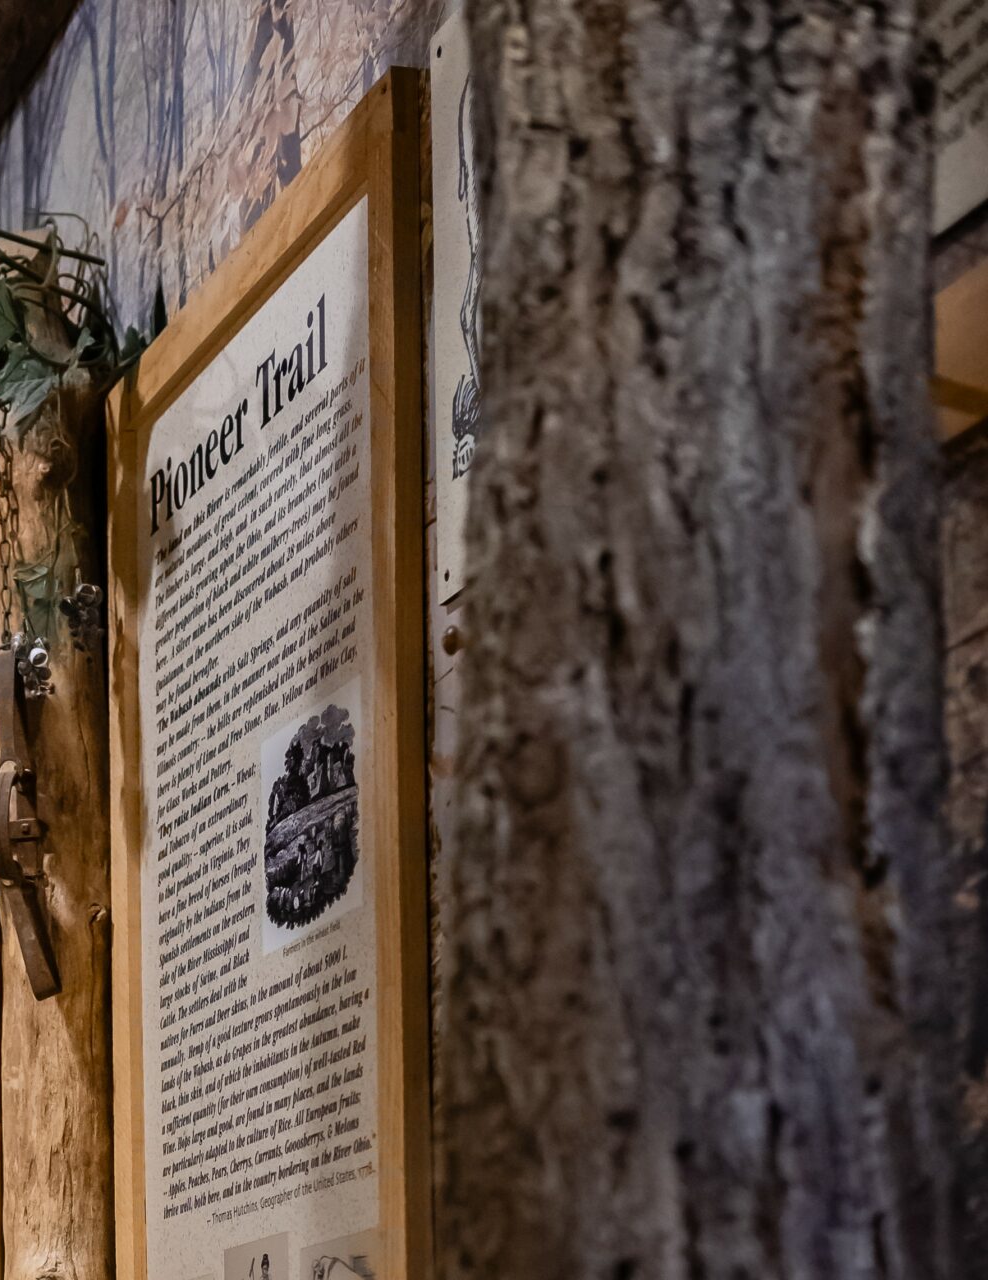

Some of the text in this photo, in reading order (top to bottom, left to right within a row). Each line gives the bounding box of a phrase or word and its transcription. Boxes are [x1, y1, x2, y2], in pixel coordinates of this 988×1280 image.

[150, 292, 327, 535] Pioneer Trail
[174, 602, 204, 638] proportion
[212, 577, 228, 601] black
[242, 553, 259, 575] white
[337, 462, 359, 498] found
[170, 696, 192, 723] Wabash
[193, 674, 221, 705] abounds
[222, 662, 235, 683] with
[236, 651, 248, 672] Salt
[303, 589, 332, 623] quantity
[342, 566, 356, 589] salt
[156, 781, 170, 798] there
[177, 763, 194, 787] plenty
[202, 747, 216, 765] Lime
[229, 728, 242, 745] Free
[282, 684, 303, 707] Yellow
[320, 657, 338, 678] White
[165, 795, 180, 812] Glass
[181, 781, 197, 800] Works
[160, 1033, 179, 1050] natives
[216, 1007, 230, 1022] Deer
[268, 973, 293, 996] amount
[302, 958, 322, 979] about
[188, 1042, 203, 1058] Hemp
[216, 1025, 231, 1049] good
[232, 1018, 253, 1037] texture
[254, 1009, 272, 1031] grows
[274, 985, 320, 1019] spontaneously
[166, 1112, 191, 1135] sufficient
[192, 1102, 215, 1125] quantity
[229, 1089, 244, 1106] their
[313, 1042, 351, 1070] well-tasted
[177, 1131, 190, 1151] Hops
[191, 1129, 205, 1145] large
[245, 1102, 264, 1126] found
[273, 1095, 291, 1111] many
[343, 1062, 363, 1083] lands
[171, 1150, 203, 1177] particularly
[205, 1140, 227, 1161] adapted
[246, 1127, 268, 1144] culture
[305, 1101, 337, 1122] European
[212, 1208, 232, 1223] Thomas
[259, 1186, 292, 1209] Geographer
[313, 1172, 334, 1191] United
